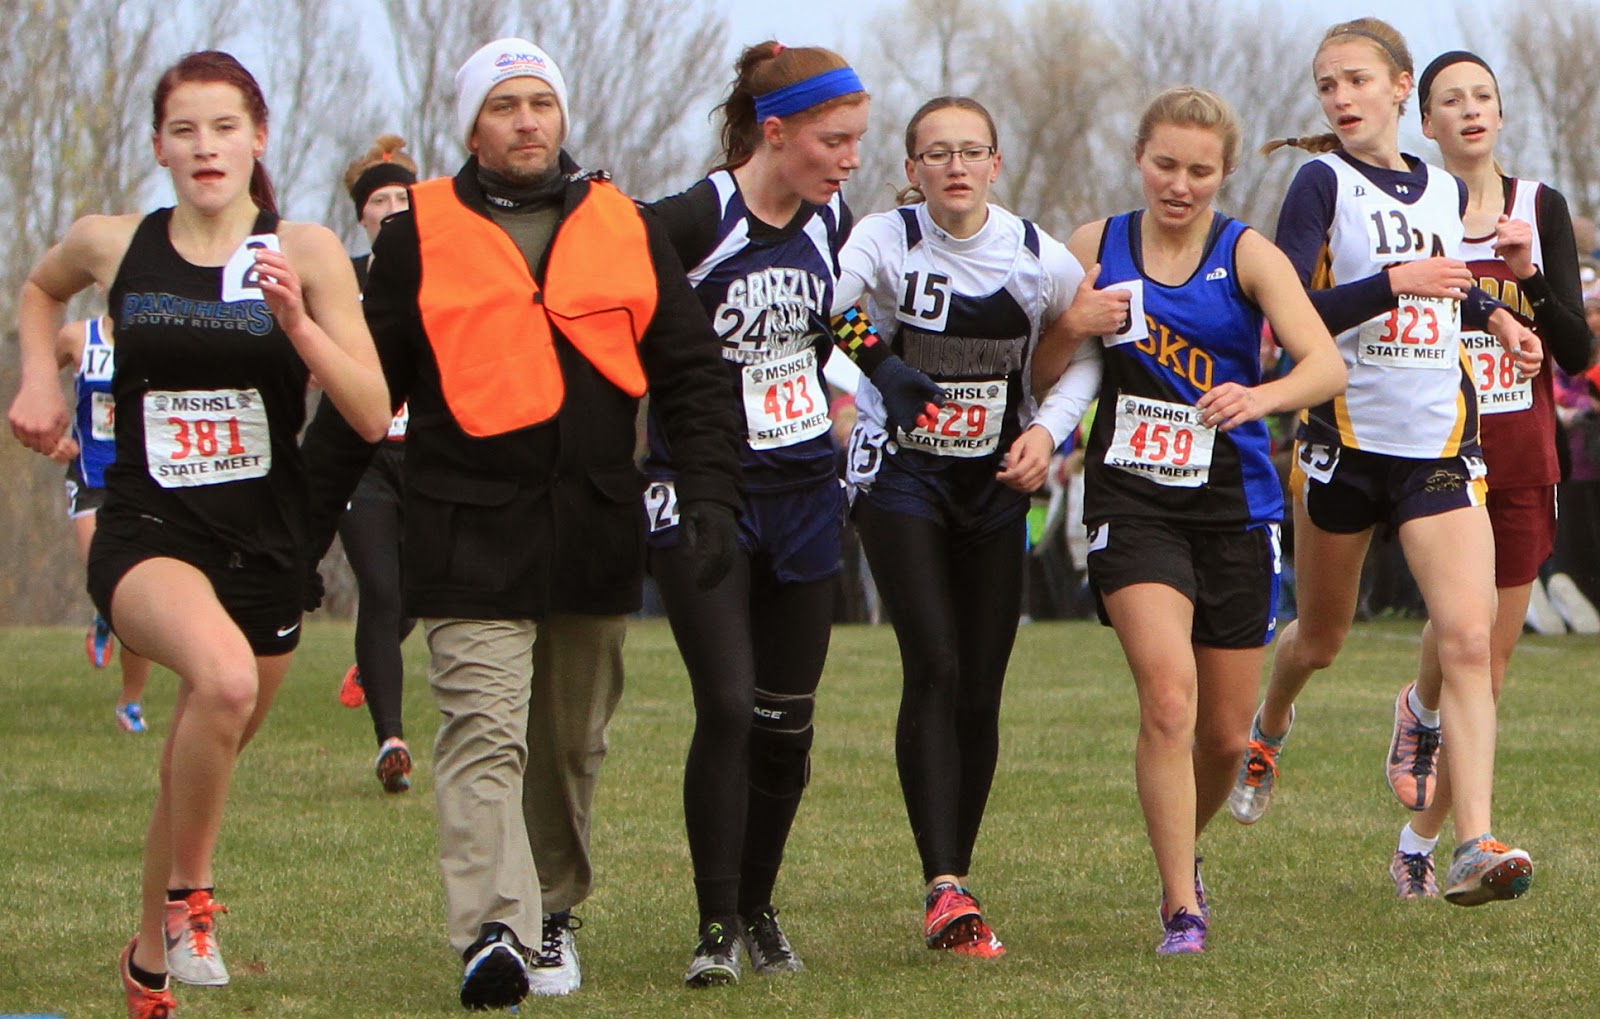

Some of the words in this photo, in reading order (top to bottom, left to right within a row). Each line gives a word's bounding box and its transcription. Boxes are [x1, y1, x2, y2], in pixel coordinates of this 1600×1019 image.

[1370, 210, 1412, 254] 13
[726, 268, 826, 316] GRIZZLY
[900, 271, 948, 320] 15
[121, 293, 274, 336] PANTHERS
[192, 318, 247, 331] RIDGE
[1379, 305, 1440, 345] 323
[721, 307, 768, 351] 24
[87, 349, 111, 375] 17
[1134, 314, 1214, 393] SKO
[1366, 344, 1409, 358] STATE
[1413, 347, 1446, 359] MEET
[766, 361, 806, 381] MSHSL
[172, 396, 237, 412] MSHSL
[763, 375, 814, 423] 423
[944, 387, 984, 400] SHSL
[1492, 390, 1525, 404] MEET
[757, 424, 798, 440] STATE
[801, 413, 827, 431] MEET
[1137, 404, 1193, 424] MSHSL
[168, 416, 245, 460] 381
[953, 437, 993, 449] MEET
[1129, 422, 1194, 466] 459
[159, 463, 210, 478] STATE
[214, 456, 262, 471] MEET
[1112, 457, 1155, 474] STATE
[1159, 464, 1200, 478] MEET
[651, 485, 680, 528] 2
